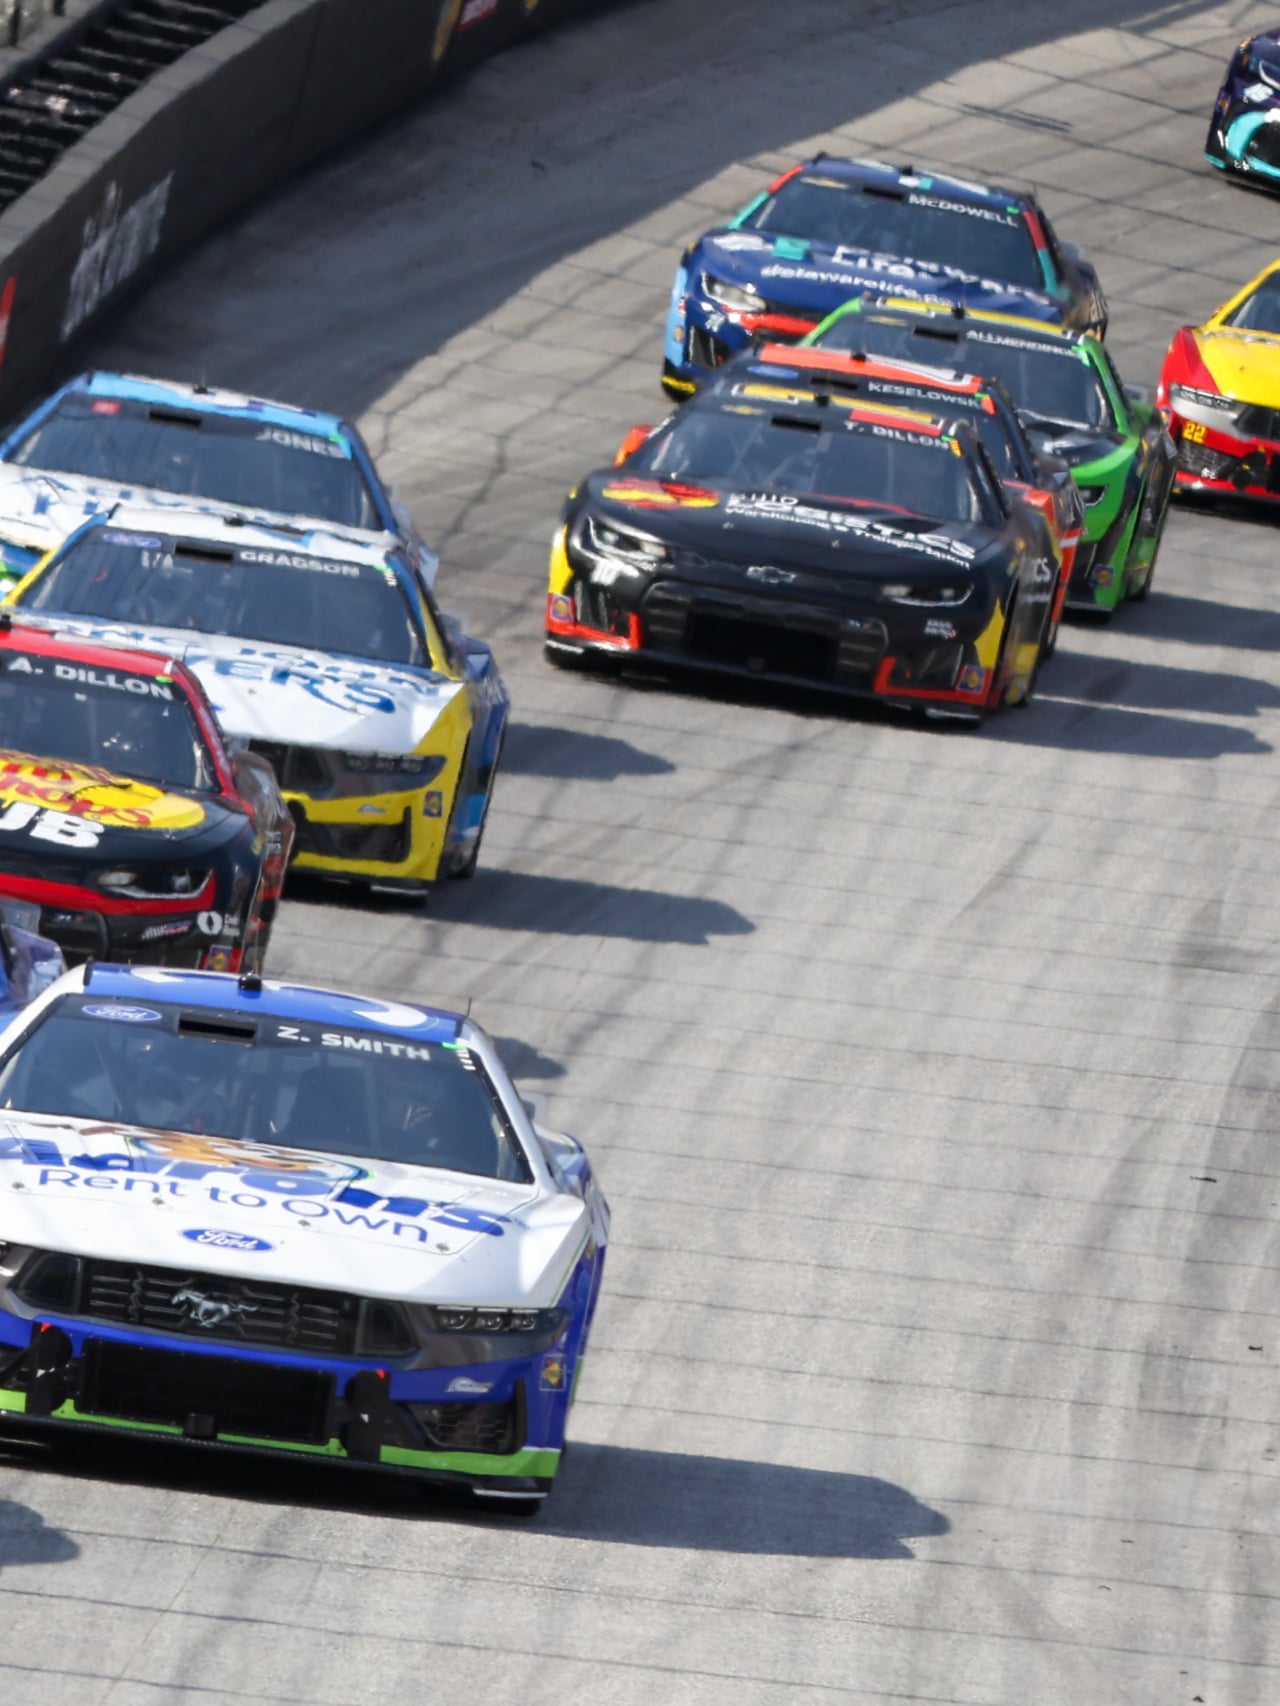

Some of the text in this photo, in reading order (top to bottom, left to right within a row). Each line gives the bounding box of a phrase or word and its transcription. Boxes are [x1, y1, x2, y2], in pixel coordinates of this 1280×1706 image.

[256, 431, 346, 459] JONES
[844, 420, 951, 449] T. DILLON
[1183, 420, 1207, 444] 22
[240, 551, 361, 577] GRAGSON
[8, 656, 173, 700] A. DILLON
[277, 1025, 430, 1061] Z. SMITH
[38, 1169, 428, 1243] Rent to Own
